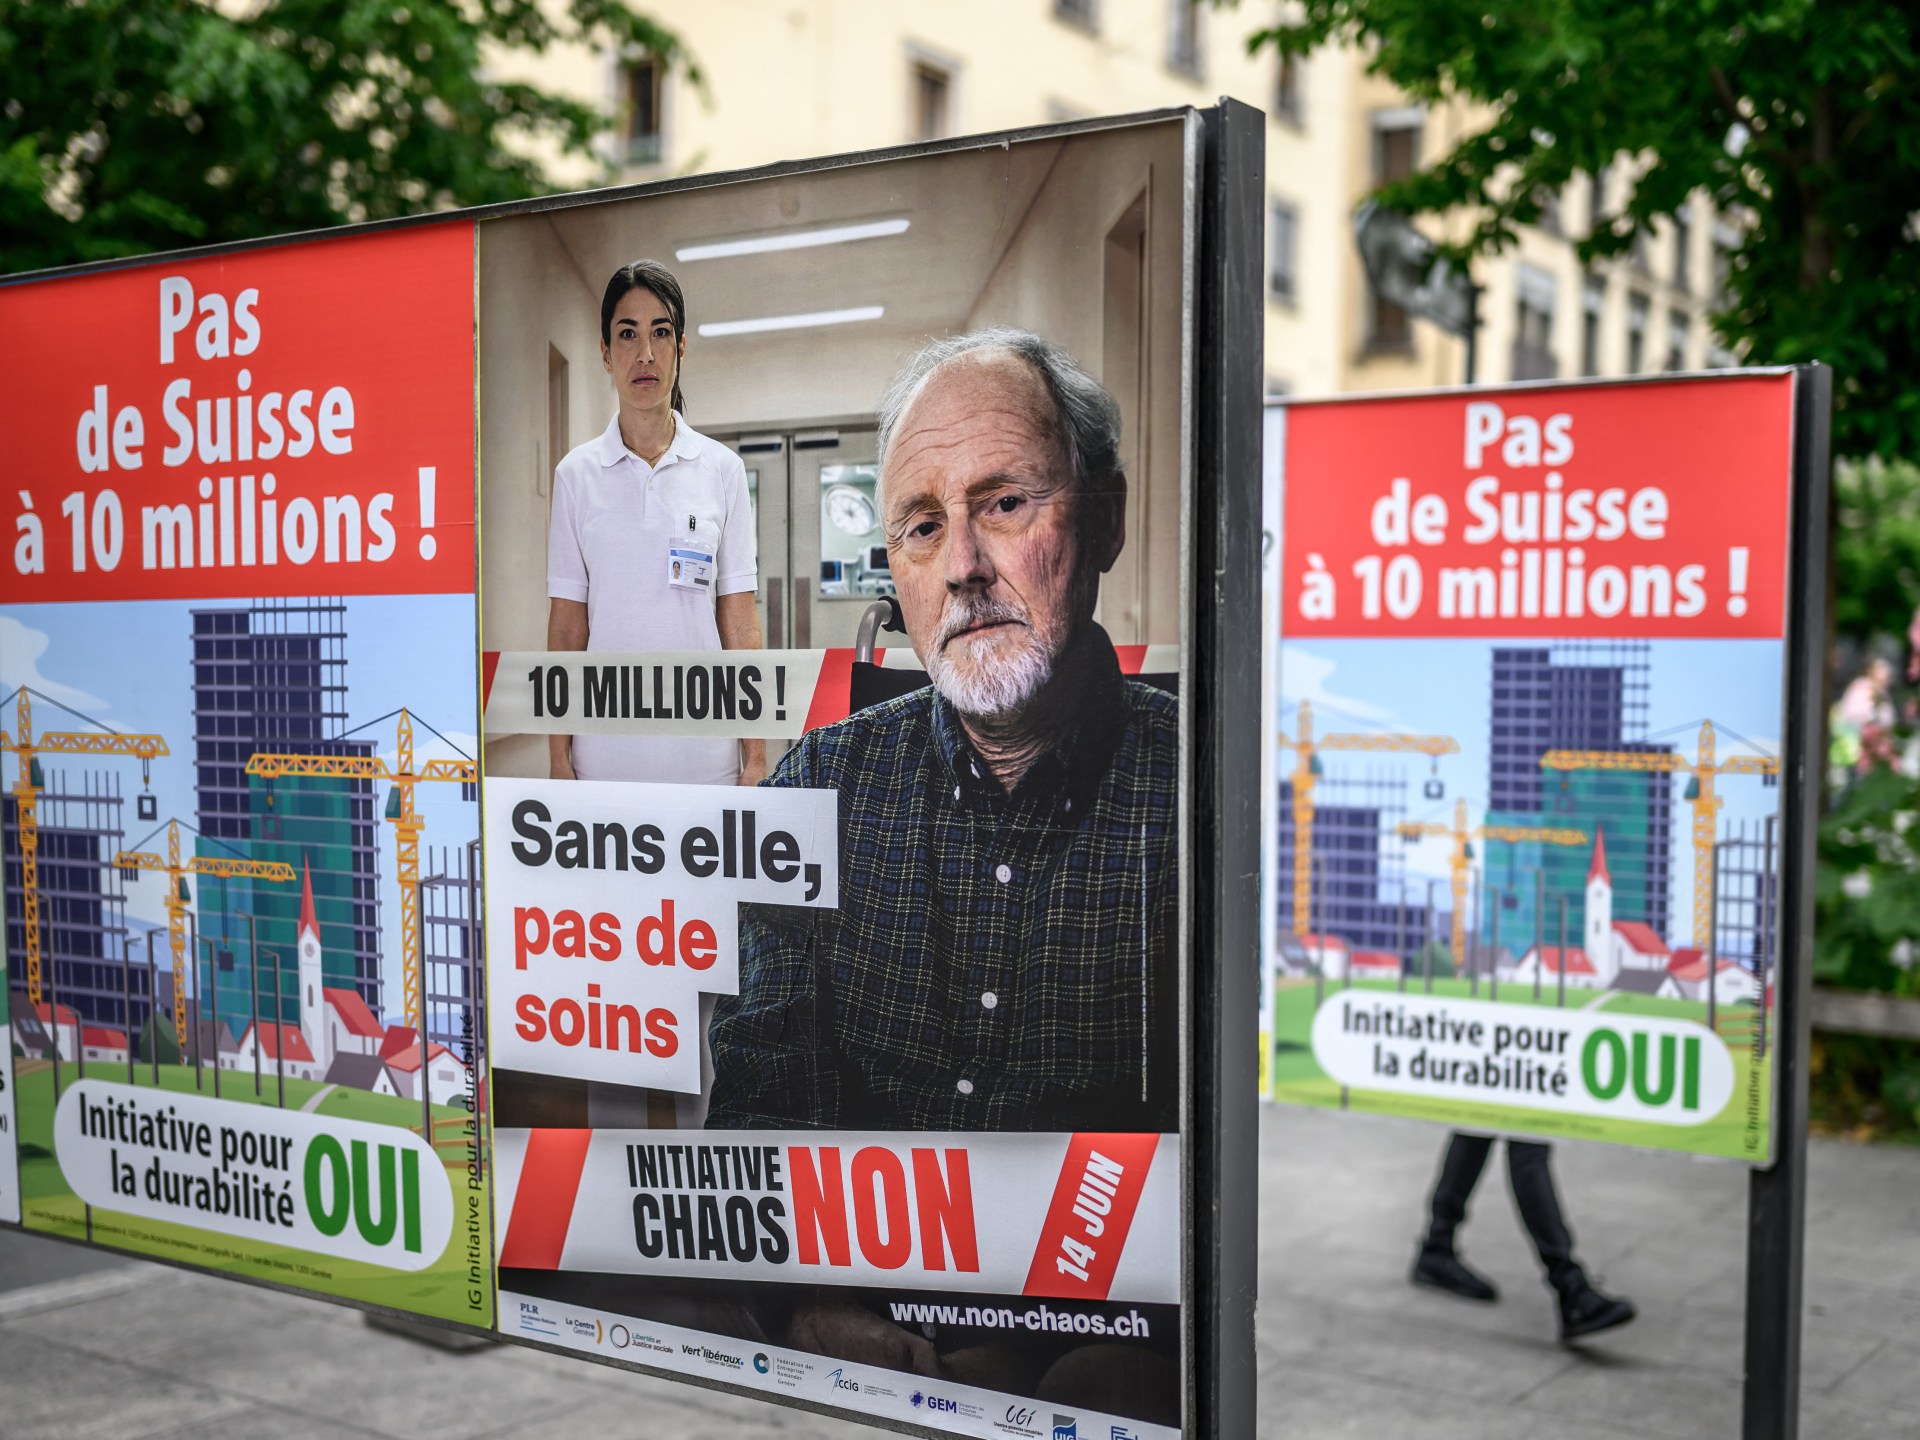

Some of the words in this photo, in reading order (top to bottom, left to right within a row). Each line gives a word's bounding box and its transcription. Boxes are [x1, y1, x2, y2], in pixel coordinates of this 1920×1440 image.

[160, 275, 261, 365] Pas
[76, 384, 145, 474] de
[162, 368, 355, 468] Suisse
[1464, 402, 1575, 469] Pas
[14, 490, 44, 575] à
[61, 488, 124, 572] 10
[141, 472, 397, 570] millions
[418, 466, 437, 560] !
[1372, 479, 1448, 546] de
[1464, 472, 1668, 545] Suisse
[1300, 554, 1335, 620] à
[1353, 554, 1422, 620] 10
[1438, 547, 1707, 619] millions
[1726, 547, 1749, 618] !
[528, 665, 569, 718] 10
[582, 665, 763, 721] MILLIONS
[775, 665, 787, 721] !
[511, 799, 666, 875] Sans
[680, 809, 822, 902] elle,
[514, 906, 622, 970] pas
[636, 899, 718, 971] de
[515, 983, 679, 1058] soins
[1343, 1002, 1484, 1046] Initiative
[1494, 1023, 1571, 1055] pour
[461, 1014, 474, 1114] durabilité
[1375, 1043, 1399, 1076] la
[1411, 1049, 1568, 1096] durabilité
[1581, 1027, 1701, 1110] OUI
[79, 1092, 212, 1157] Initiative
[221, 1126, 293, 1172] pour
[463, 1119, 476, 1138] la
[111, 1148, 136, 1197] la
[144, 1155, 294, 1228] durabilité
[467, 1139, 482, 1190] pour
[626, 1145, 783, 1191] INITIATIVE
[304, 1133, 422, 1253] OUI
[788, 1146, 980, 1273] NON
[1072, 1150, 1124, 1238] JUIN
[468, 1196, 481, 1286] Initiative
[633, 1193, 790, 1264] CHAOS
[1056, 1235, 1096, 1282] 14
[469, 1290, 482, 1311] IG
[520, 1303, 539, 1314] PLR
[574, 1320, 595, 1330] Centre
[890, 1303, 1149, 1337] www.non-chaos.ch
[573, 1326, 595, 1337] Genève
[632, 1333, 655, 1343] Libertés
[632, 1340, 652, 1350] Justice
[653, 1344, 673, 1354] sociale
[777, 1358, 804, 1368] Fédération
[805, 1362, 814, 1370] des
[777, 1365, 805, 1375] Entreprises
[777, 1371, 802, 1381] Romandes
[778, 1378, 796, 1387] Genève
[928, 1396, 957, 1413] GEM
